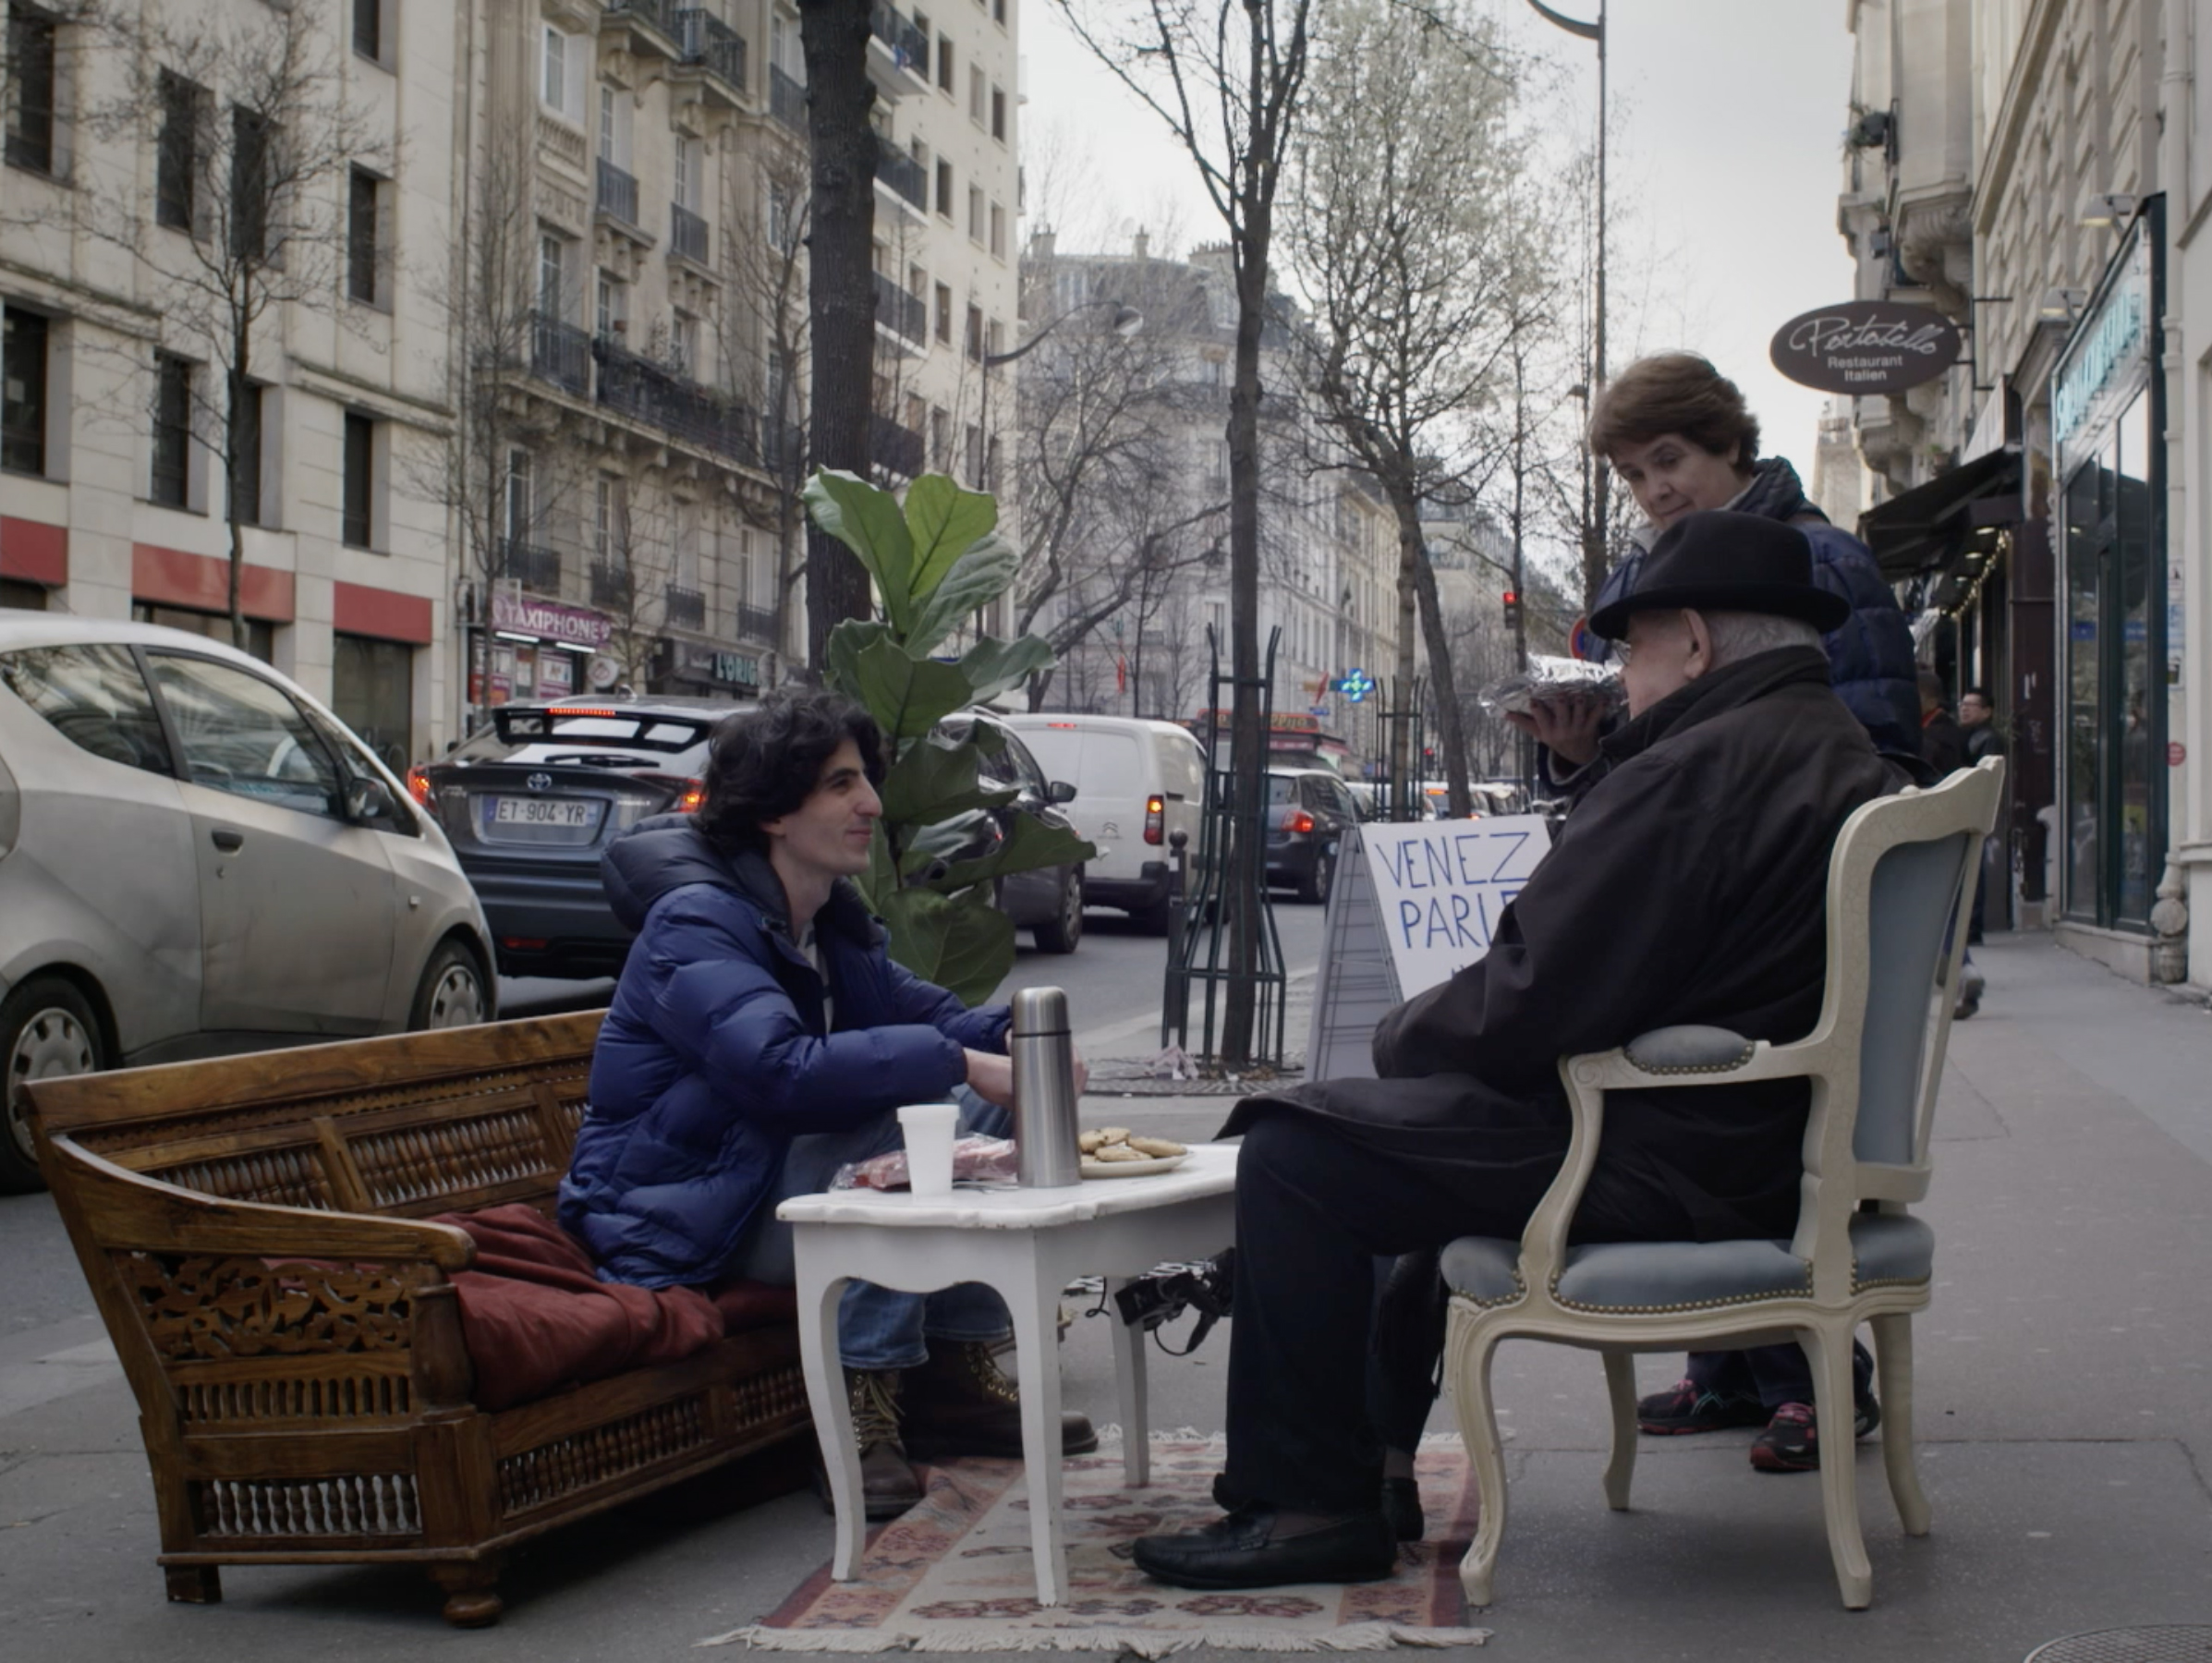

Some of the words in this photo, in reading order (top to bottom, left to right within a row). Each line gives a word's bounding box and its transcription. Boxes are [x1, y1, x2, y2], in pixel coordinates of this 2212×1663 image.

[1827, 355, 1903, 370] Restaurant
[1844, 370, 1888, 382] Italien
[504, 603, 600, 640] TAXIPHONE
[1375, 832, 1531, 889] VENEZ
